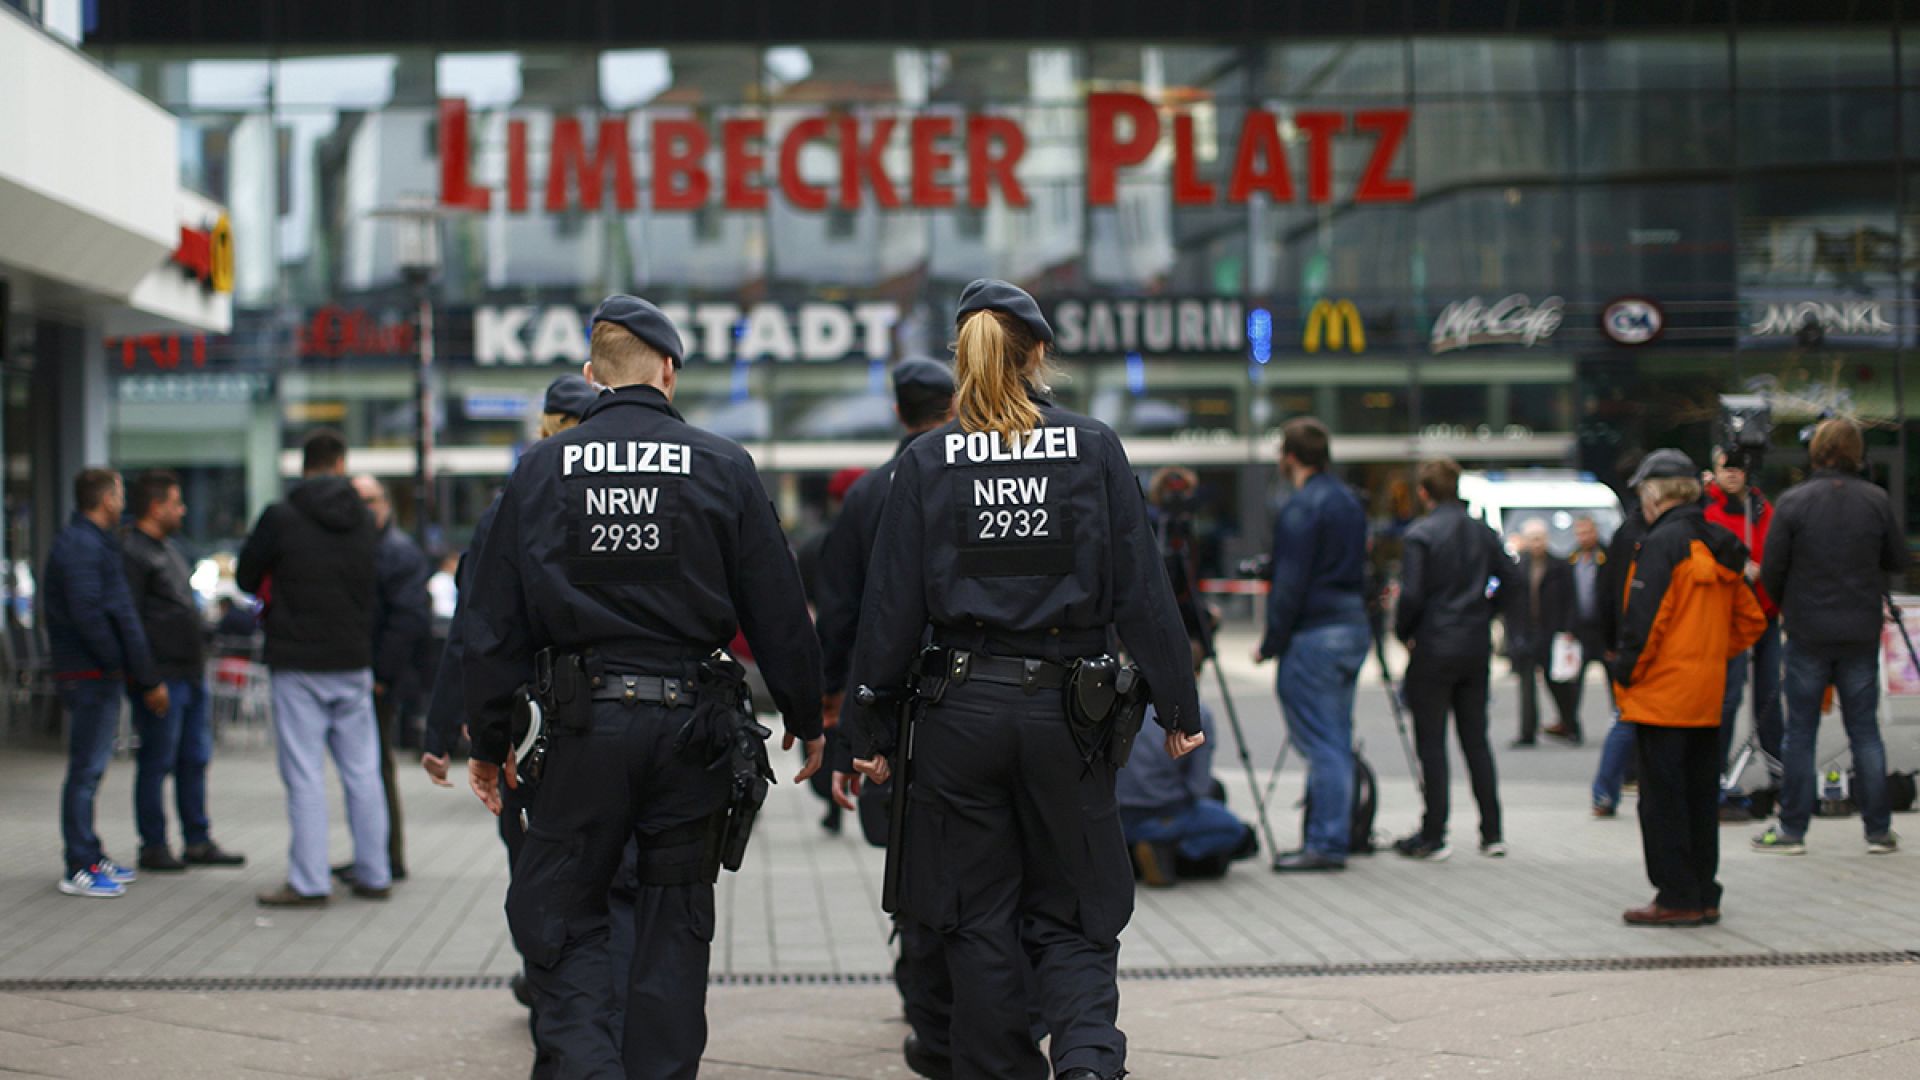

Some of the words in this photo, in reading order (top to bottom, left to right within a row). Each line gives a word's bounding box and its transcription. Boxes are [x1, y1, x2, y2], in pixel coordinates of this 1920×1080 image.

[439, 98, 1027, 212] LIMBECKER
[1087, 90, 1415, 206] PLATZ
[473, 303, 899, 366] KASTADT
[1055, 301, 1244, 352] SATURN
[562, 441, 692, 476] POLIZEI
[945, 426, 1078, 465] POLIZEI
[586, 487, 659, 515] NRW
[973, 476, 1049, 507] NRW
[591, 523, 660, 552] 2933
[978, 508, 1049, 539] 2932
